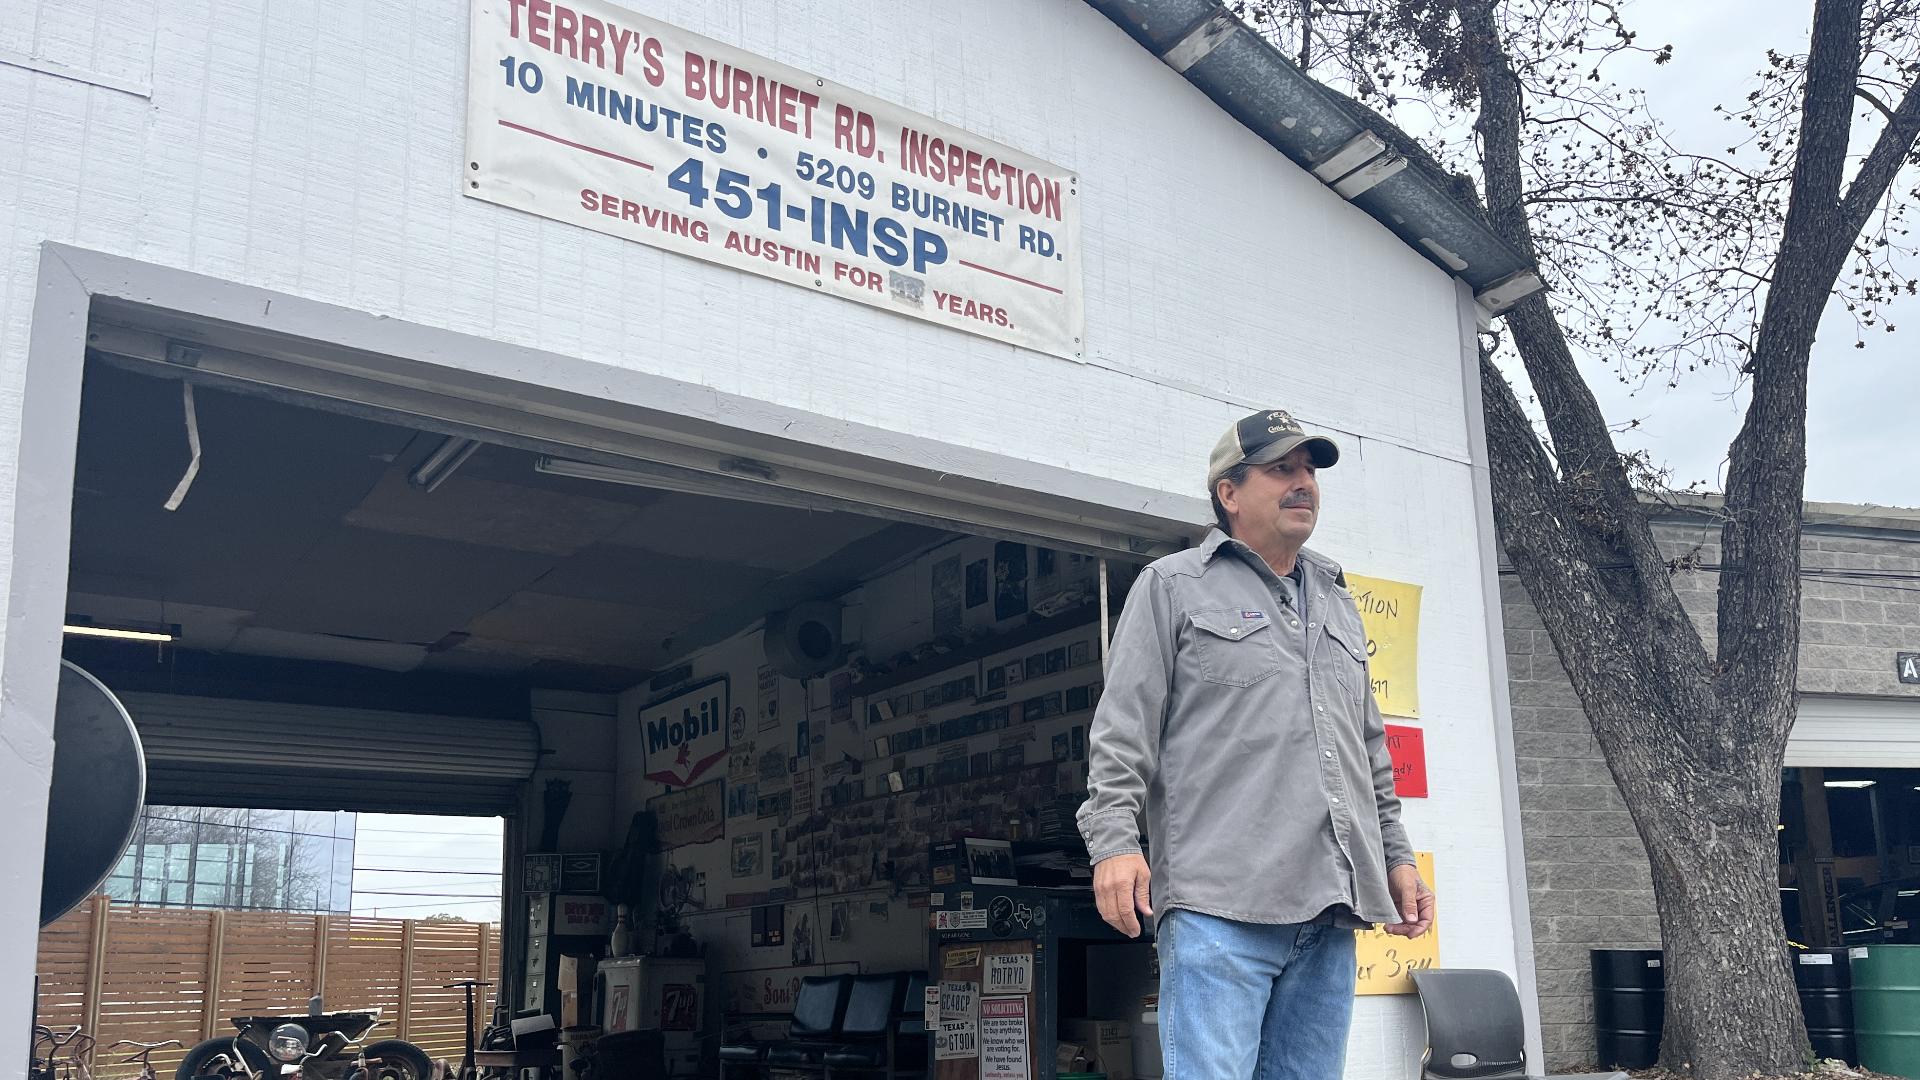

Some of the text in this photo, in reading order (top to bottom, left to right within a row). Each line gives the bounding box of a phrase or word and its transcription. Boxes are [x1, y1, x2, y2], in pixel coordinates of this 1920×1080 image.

[507, 0, 1062, 221] TERRY'S BURNET RD. INSPECTION
[499, 55, 1062, 261] 10 MINUTES 5209 BURNET RD.
[667, 157, 948, 275] 451-INSP
[580, 188, 709, 244] SERVING
[724, 230, 821, 275] AUSTIN
[834, 261, 883, 293] FOR
[933, 290, 1015, 329] YEARS.
[1903, 658, 1918, 678] A
[647, 697, 719, 755] Mobil
[998, 955, 1018, 964] TEXAS
[1385, 948, 1401, 978] 3
[943, 1022, 965, 1032] TEXAS
